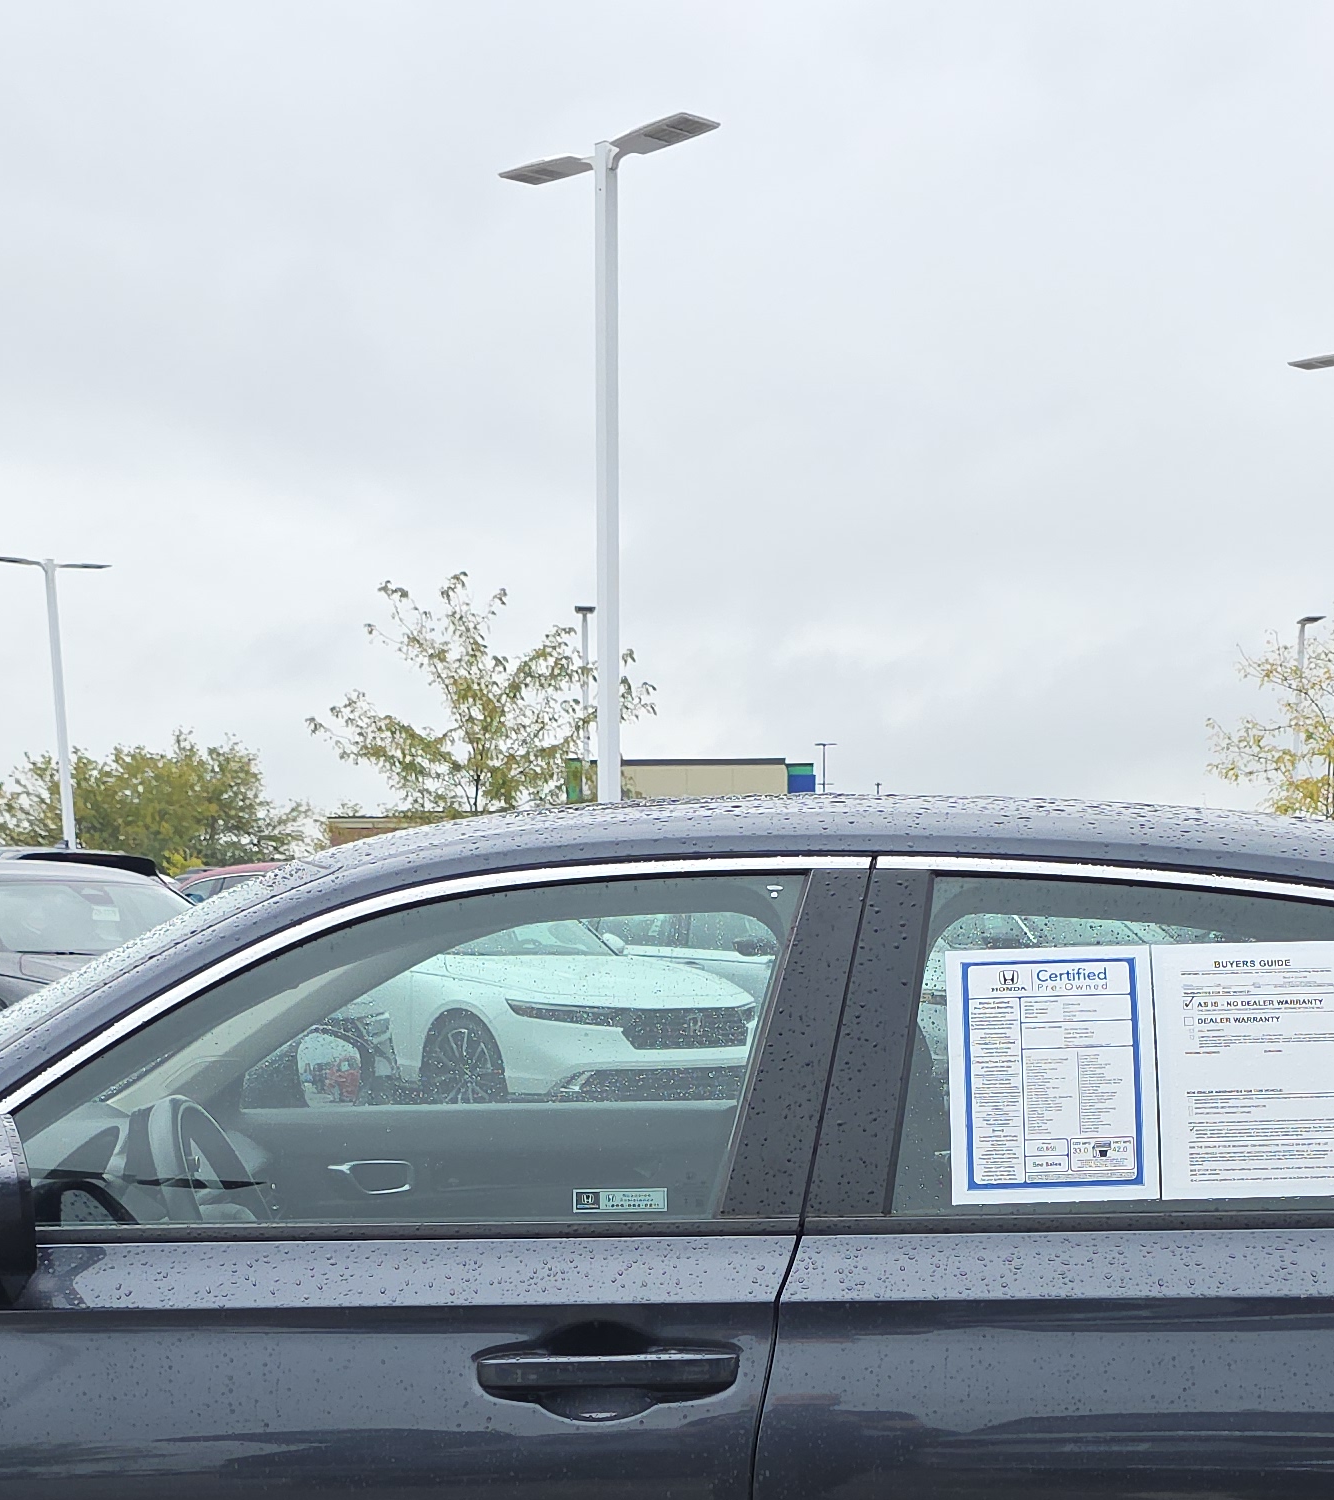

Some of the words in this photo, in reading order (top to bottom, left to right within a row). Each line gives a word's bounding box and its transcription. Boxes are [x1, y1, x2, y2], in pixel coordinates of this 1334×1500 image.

[1213, 960, 1256, 968] BUYERS
[1259, 959, 1292, 967] GUIDE
[1036, 967, 1108, 982] Certified
[1037, 982, 1108, 992] Pre-Owned
[1072, 1147, 1088, 1155] 33.0
